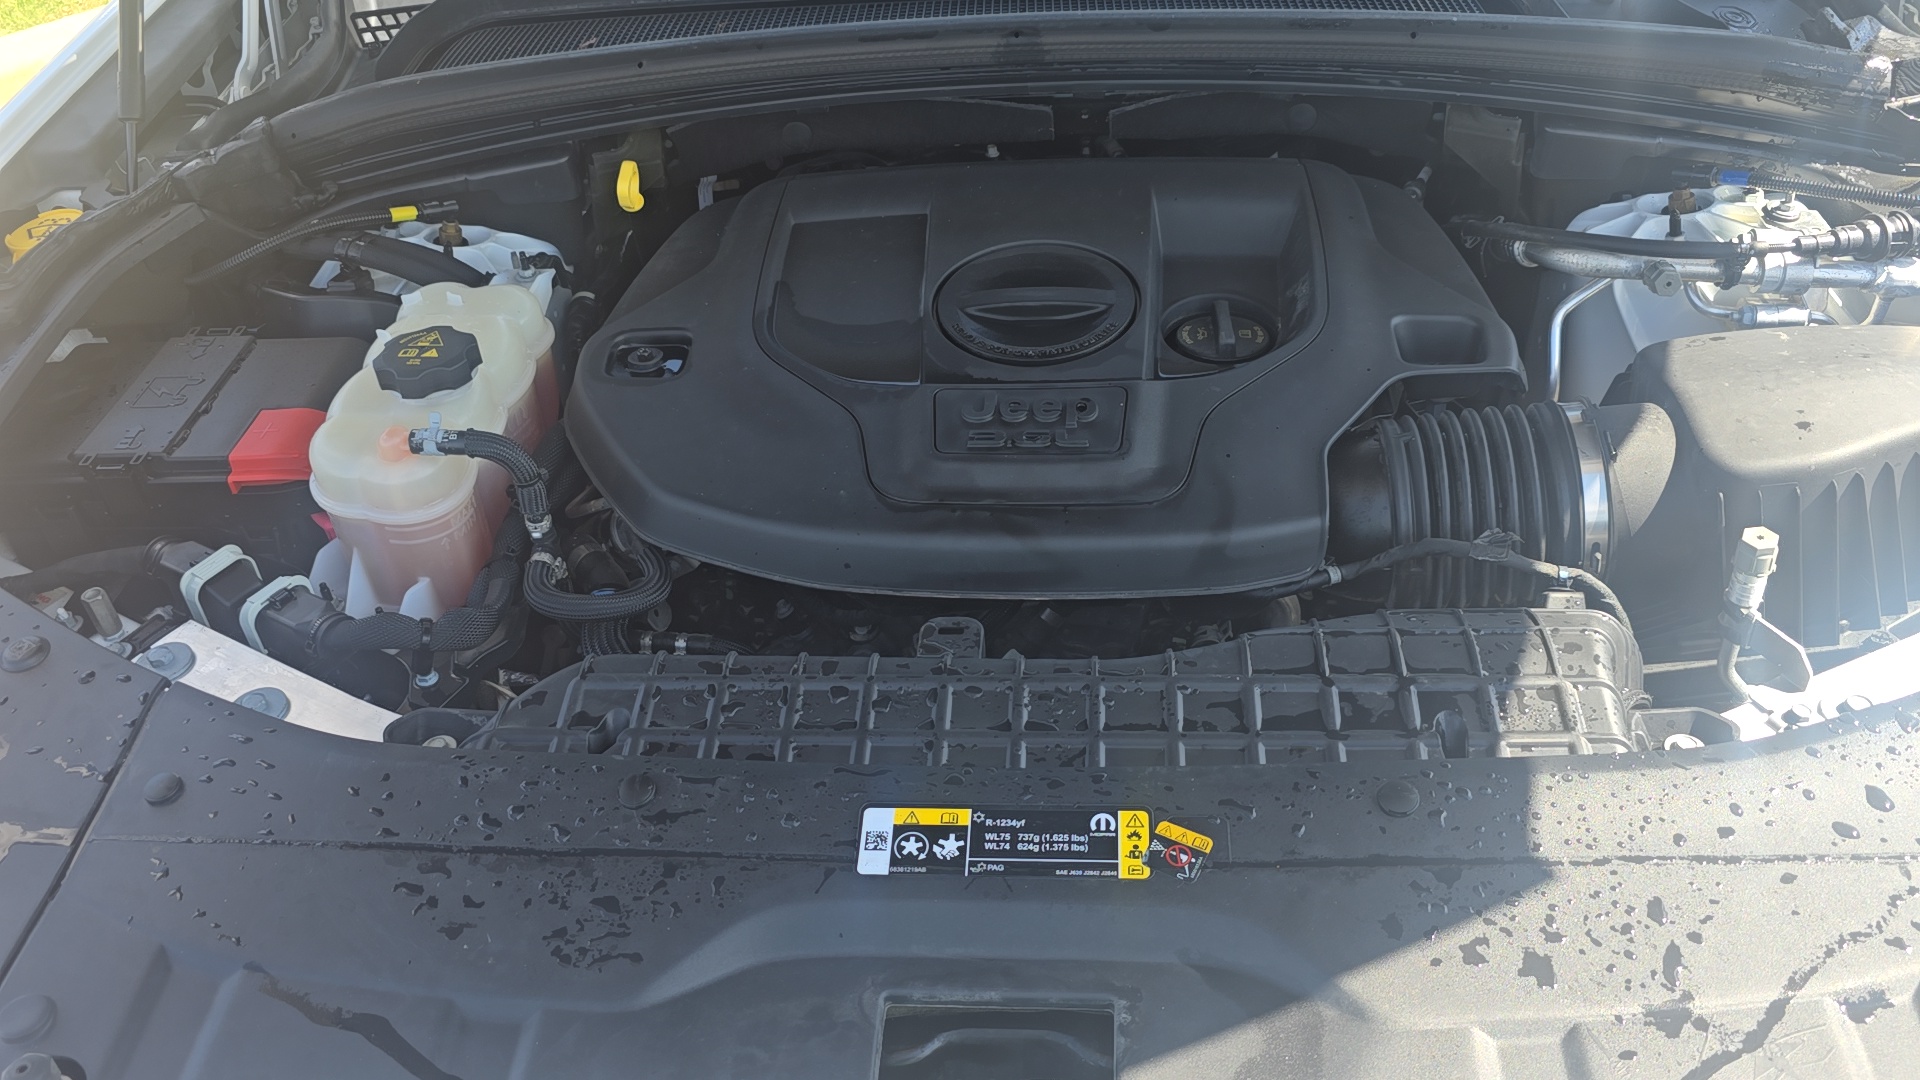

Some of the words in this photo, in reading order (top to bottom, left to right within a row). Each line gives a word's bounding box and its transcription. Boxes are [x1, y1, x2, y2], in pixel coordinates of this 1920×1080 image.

[961, 390, 1099, 428] Jeep
[967, 429, 1090, 448] 3.6L
[985, 819, 1026, 828] R-1234yf
[984, 833, 1011, 841] WL75
[1017, 833, 1040, 843] 737g
[1041, 833, 1070, 843] (1.625
[1071, 834, 1089, 843] lbs)
[984, 842, 1011, 850] WL74
[1017, 843, 1040, 852] 624g
[1041, 843, 1070, 852] (1.375
[1071, 843, 1089, 853] lbs)
